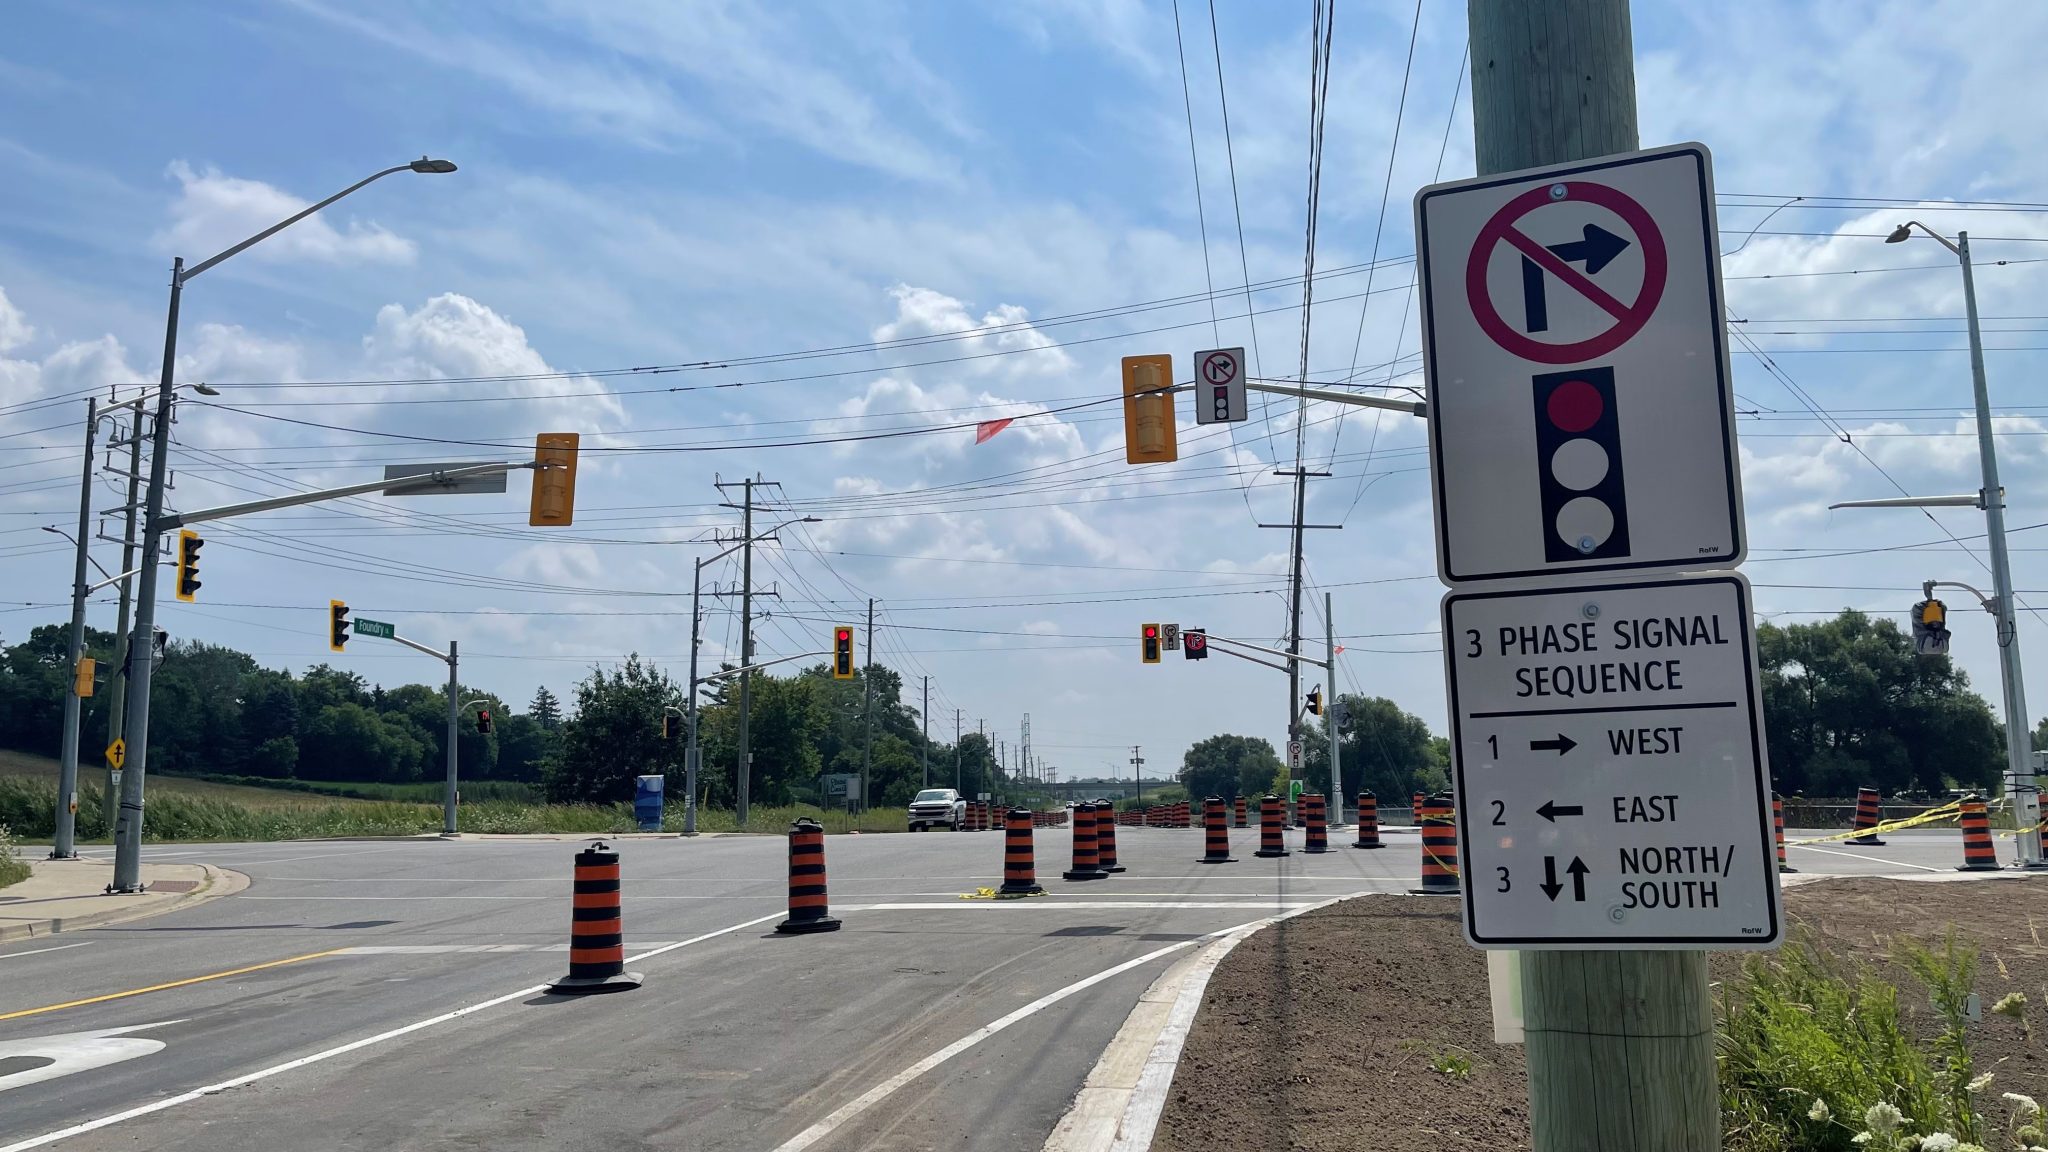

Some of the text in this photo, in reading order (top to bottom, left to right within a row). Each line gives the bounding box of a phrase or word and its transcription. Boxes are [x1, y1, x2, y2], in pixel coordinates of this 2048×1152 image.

[359, 620, 385, 636] Foundry
[1466, 615, 1728, 658] 3 PHASE SIGNAL
[1516, 660, 1682, 698] SEQUENCE
[1488, 727, 1683, 760] 1 WEST
[1491, 795, 1678, 826] 2 EAST
[1497, 845, 1734, 893] 3 NORTH/
[1621, 881, 1719, 908] SOUTH
